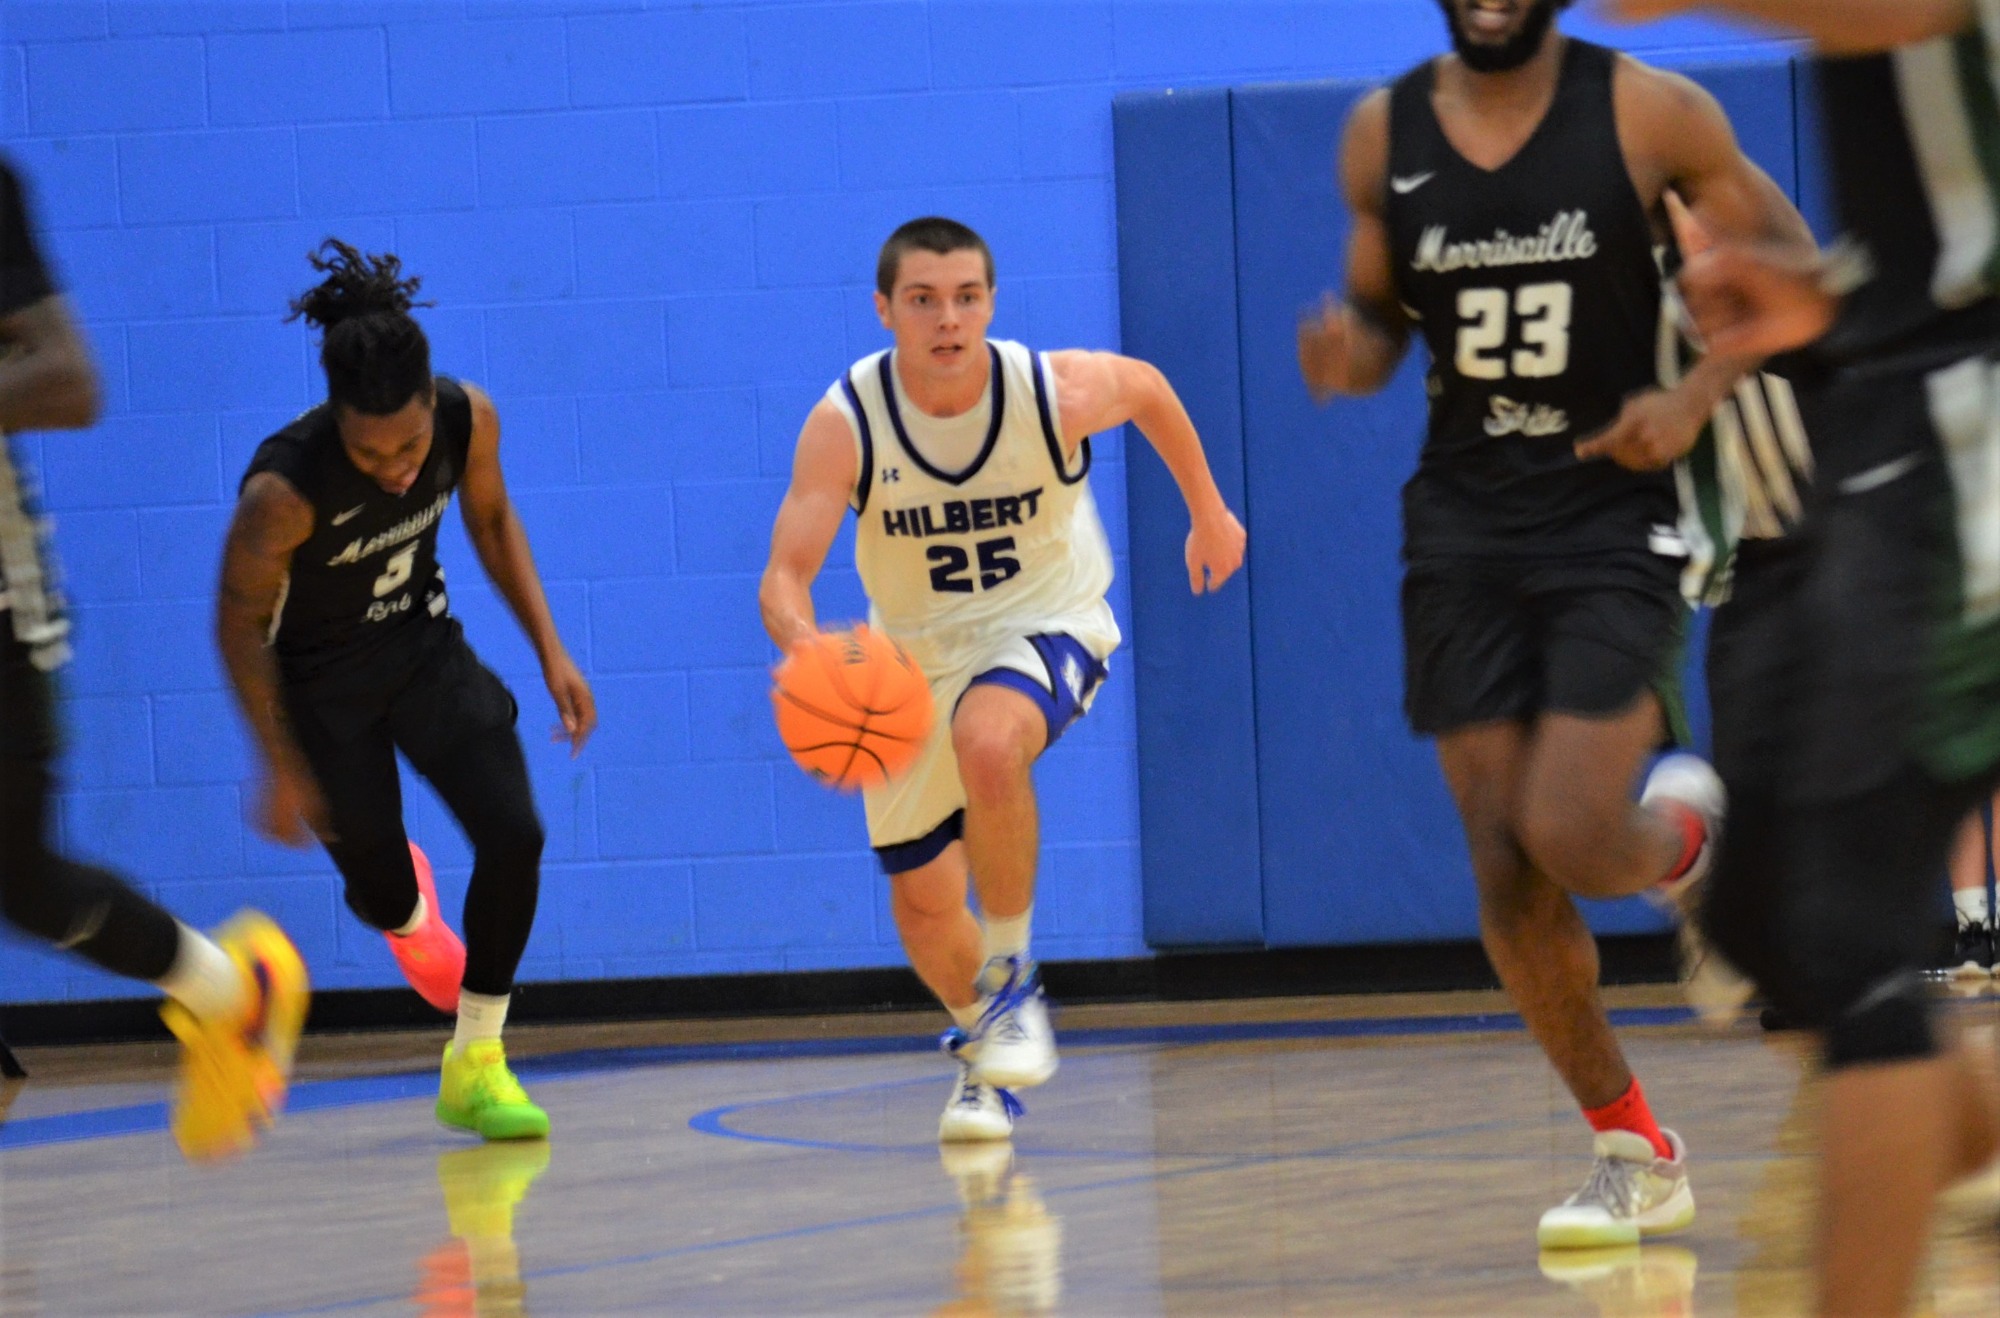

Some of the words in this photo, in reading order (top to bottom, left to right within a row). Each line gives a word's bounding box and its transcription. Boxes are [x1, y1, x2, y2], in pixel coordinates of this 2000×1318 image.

[1410, 207, 1597, 273] Morrisville
[1455, 281, 1573, 380] 23
[882, 487, 1044, 538] HILBERT
[926, 535, 1021, 593] 25
